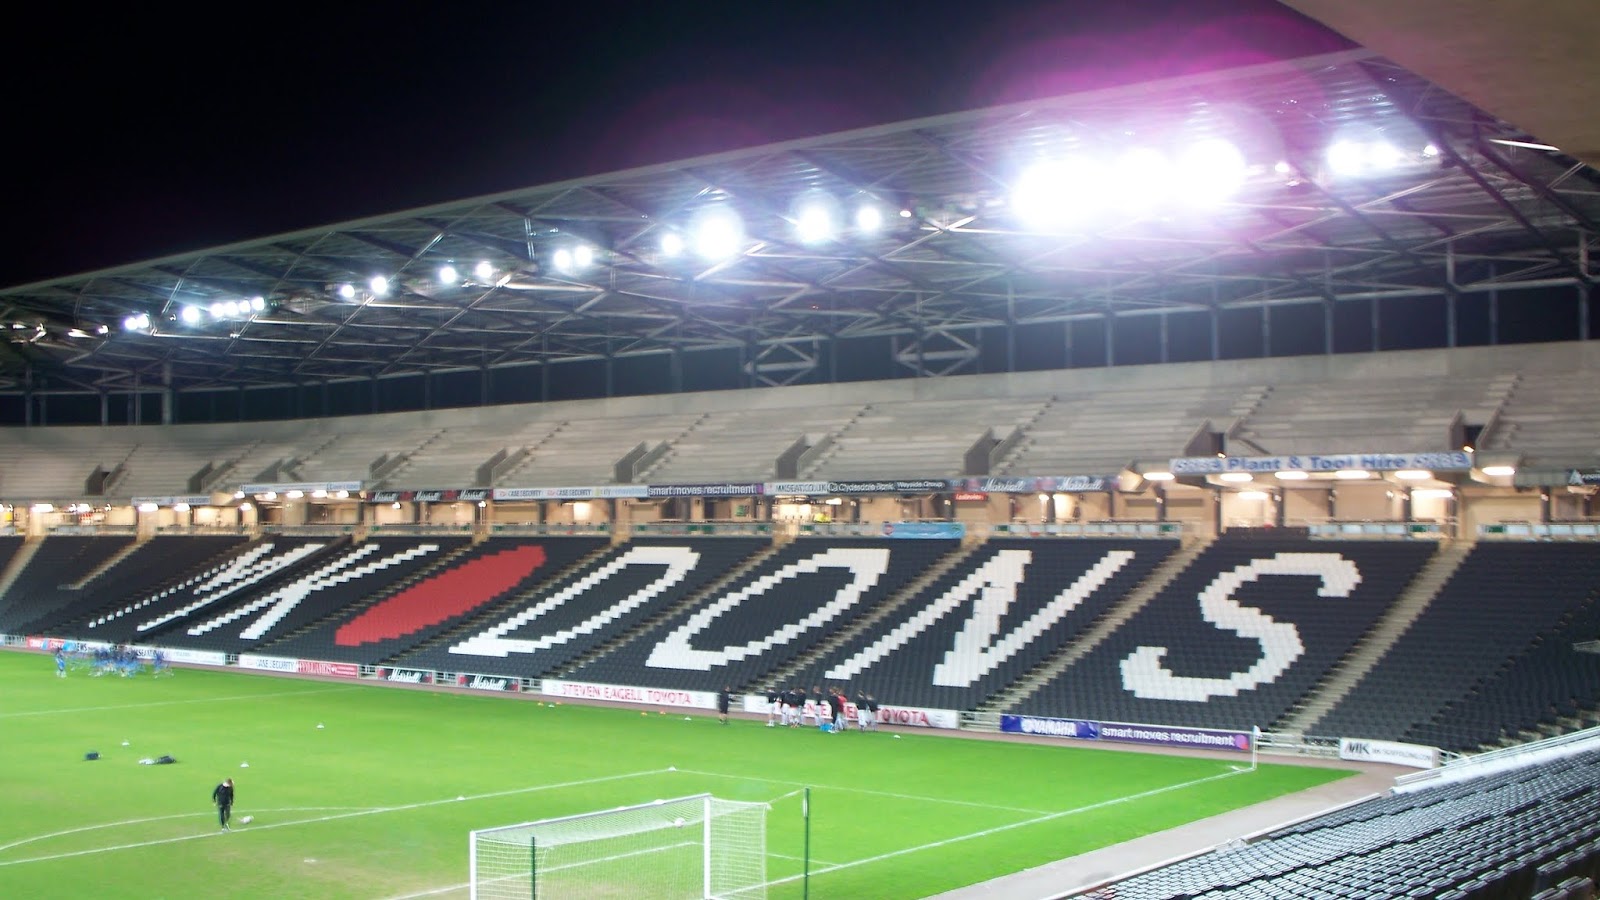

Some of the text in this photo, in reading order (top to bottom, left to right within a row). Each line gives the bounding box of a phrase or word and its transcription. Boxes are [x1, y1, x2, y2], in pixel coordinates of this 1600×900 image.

[1228, 457, 1281, 470] Plant
[1287, 456, 1303, 468] &
[1310, 455, 1354, 469] Tool
[1360, 454, 1407, 468] Hire
[980, 477, 1026, 491] Marshall
[1056, 476, 1105, 490] Marshall
[449, 546, 1362, 703] DONS
[388, 668, 422, 684] Marshall
[469, 675, 507, 691] Marshall
[562, 683, 601, 699] STEVEN
[648, 689, 692, 704] TOYOTA
[1034, 719, 1077, 737] YAMAHA
[1102, 726, 1235, 747] smart moves recruitment
